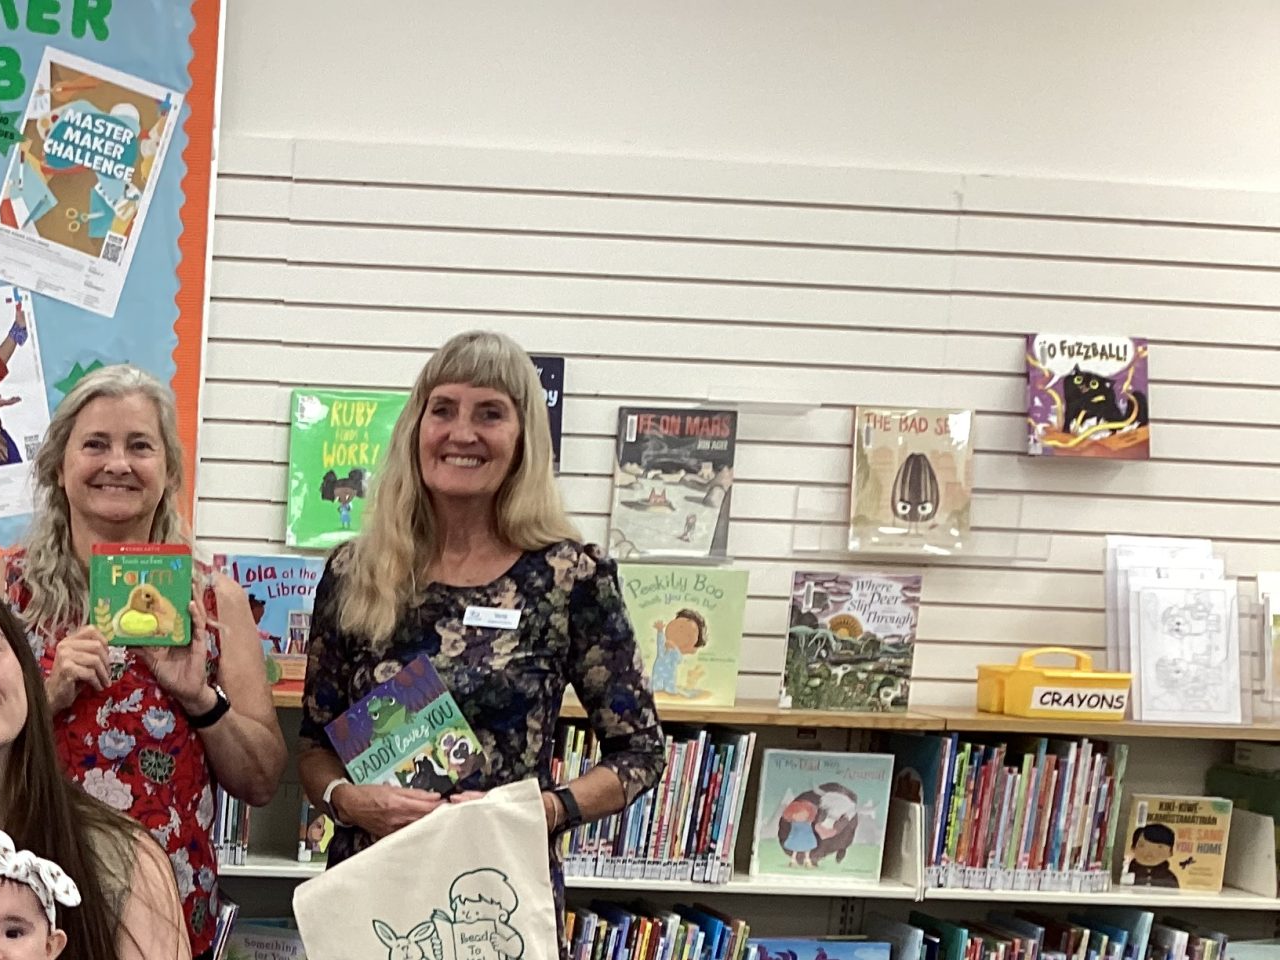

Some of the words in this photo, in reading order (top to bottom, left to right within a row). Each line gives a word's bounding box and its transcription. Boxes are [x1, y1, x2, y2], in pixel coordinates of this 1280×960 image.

[64, 109, 134, 144] MASTER
[63, 127, 124, 160] MAKER
[43, 139, 135, 182] CHALLENGE
[1060, 340, 1127, 361] FUZZBALL!
[330, 400, 378, 428] RUBY
[865, 412, 891, 432] THE
[898, 414, 928, 433] BAD
[660, 415, 680, 435] ON
[685, 416, 730, 437] MARS
[322, 441, 380, 469] WORRY
[111, 564, 173, 586] Farm
[232, 561, 277, 588] Lola
[282, 567, 294, 579] at
[299, 566, 317, 580] the
[267, 582, 314, 599] Librar
[694, 573, 724, 599] Boo
[856, 580, 893, 592] Where
[848, 599, 870, 616] Slip
[870, 591, 900, 608] Deer
[867, 611, 914, 629] Through
[1039, 691, 1124, 710] CRAYONS
[353, 734, 396, 783] DADDY
[394, 725, 430, 752] loves
[424, 701, 453, 730] YOU
[1197, 843, 1222, 855] HOME
[244, 937, 298, 957] Something
[461, 931, 489, 944] Read
[467, 945, 481, 955] To
